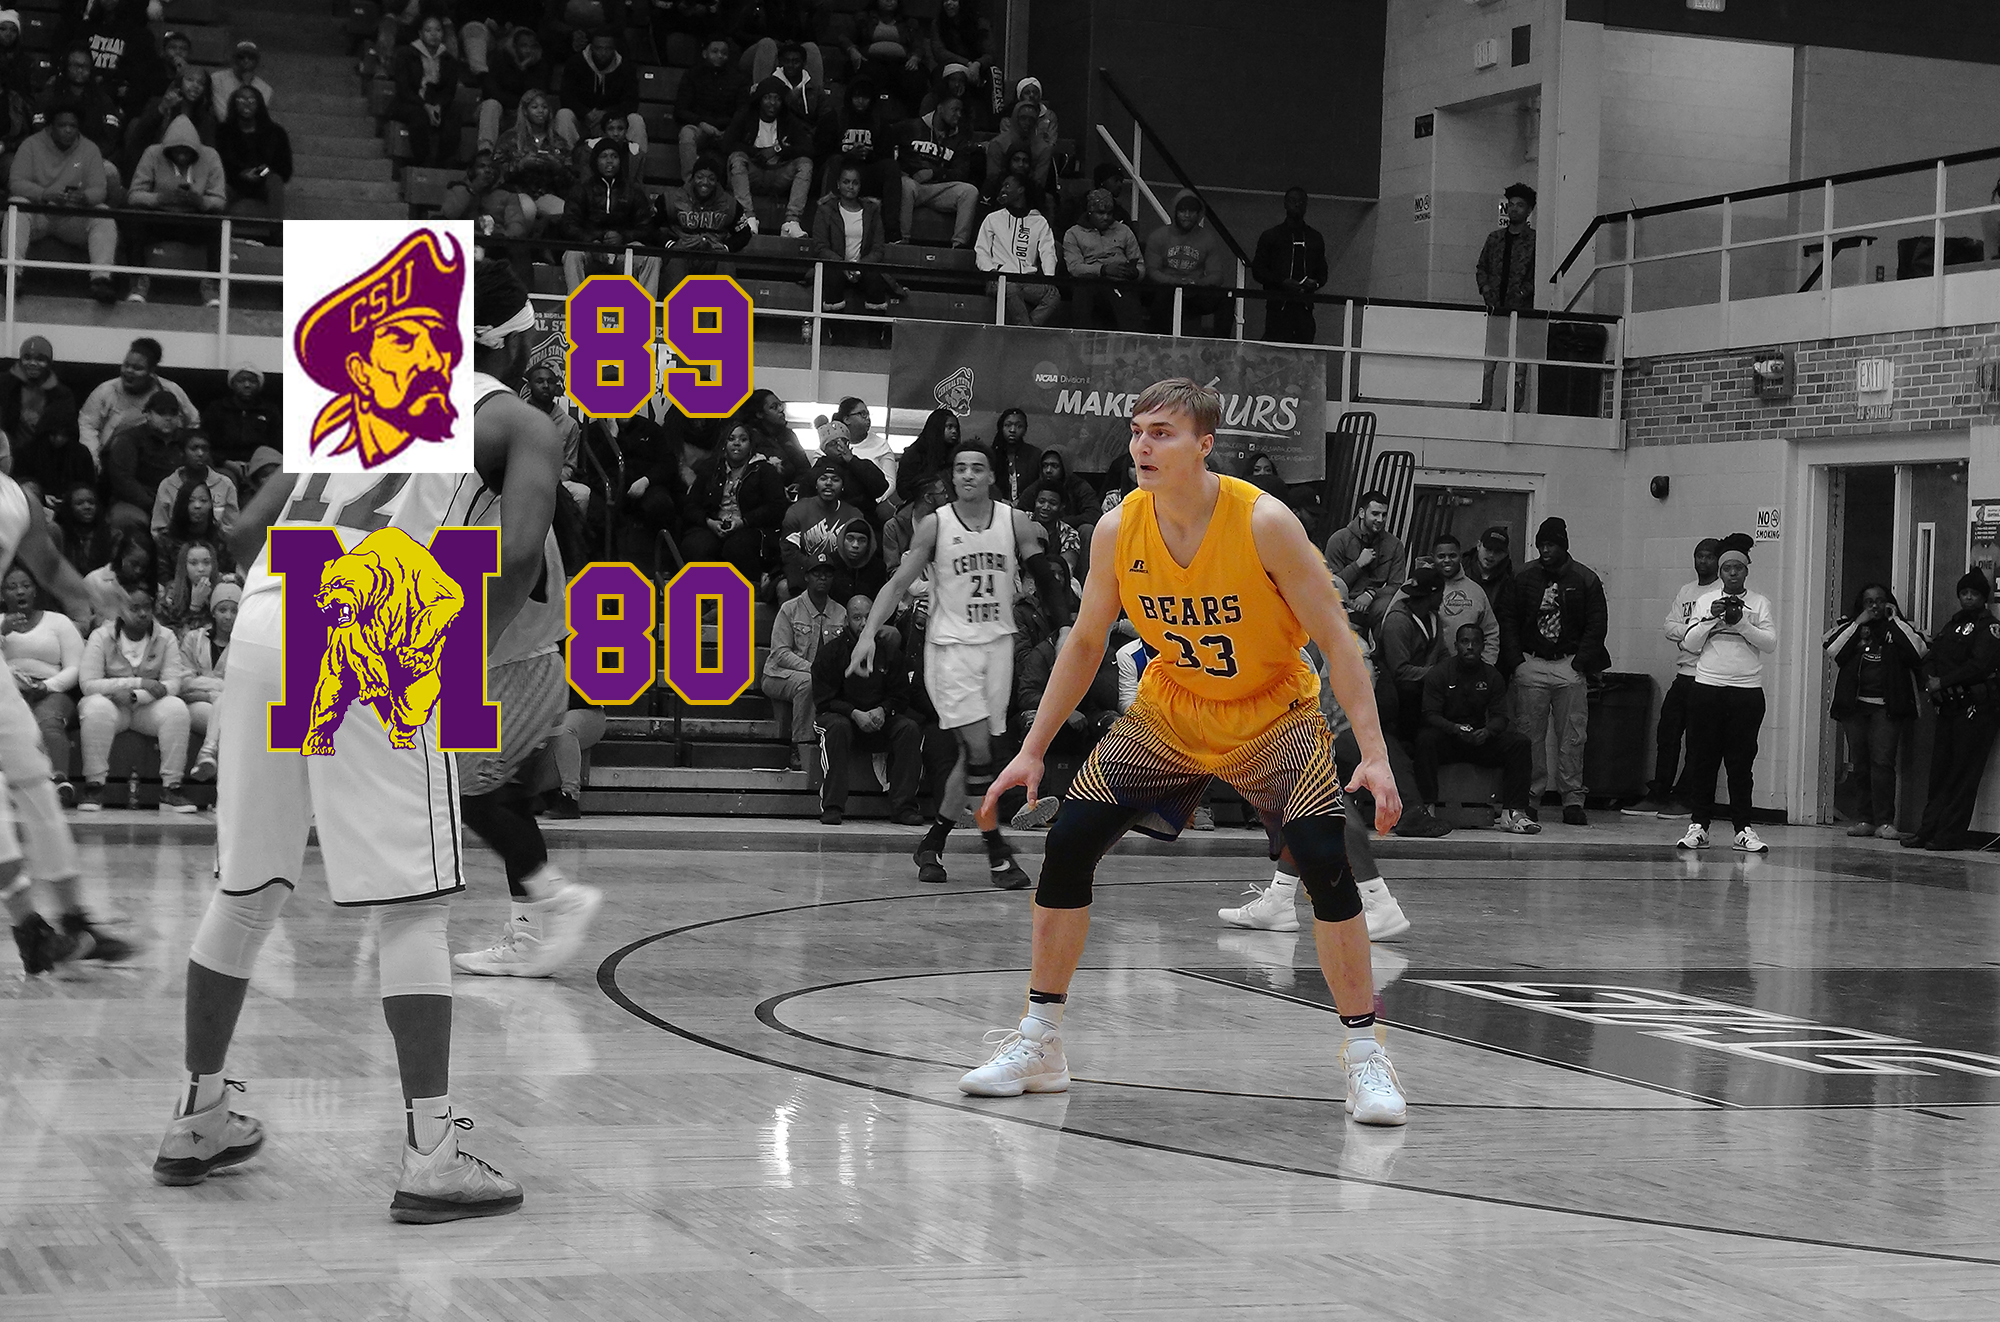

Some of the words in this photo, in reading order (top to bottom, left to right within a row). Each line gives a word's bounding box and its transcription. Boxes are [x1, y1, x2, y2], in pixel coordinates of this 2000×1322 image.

[1035, 374, 1058, 383] NCAA
[1060, 374, 1086, 384] Division
[1860, 361, 1880, 388] EXIT
[1054, 388, 1140, 418] MAKE
[1757, 511, 1770, 525] NO
[1756, 530, 1780, 539] SMOKING
[971, 574, 994, 598] 24
[1138, 594, 1242, 626] BEARS
[1163, 630, 1239, 680] 33
